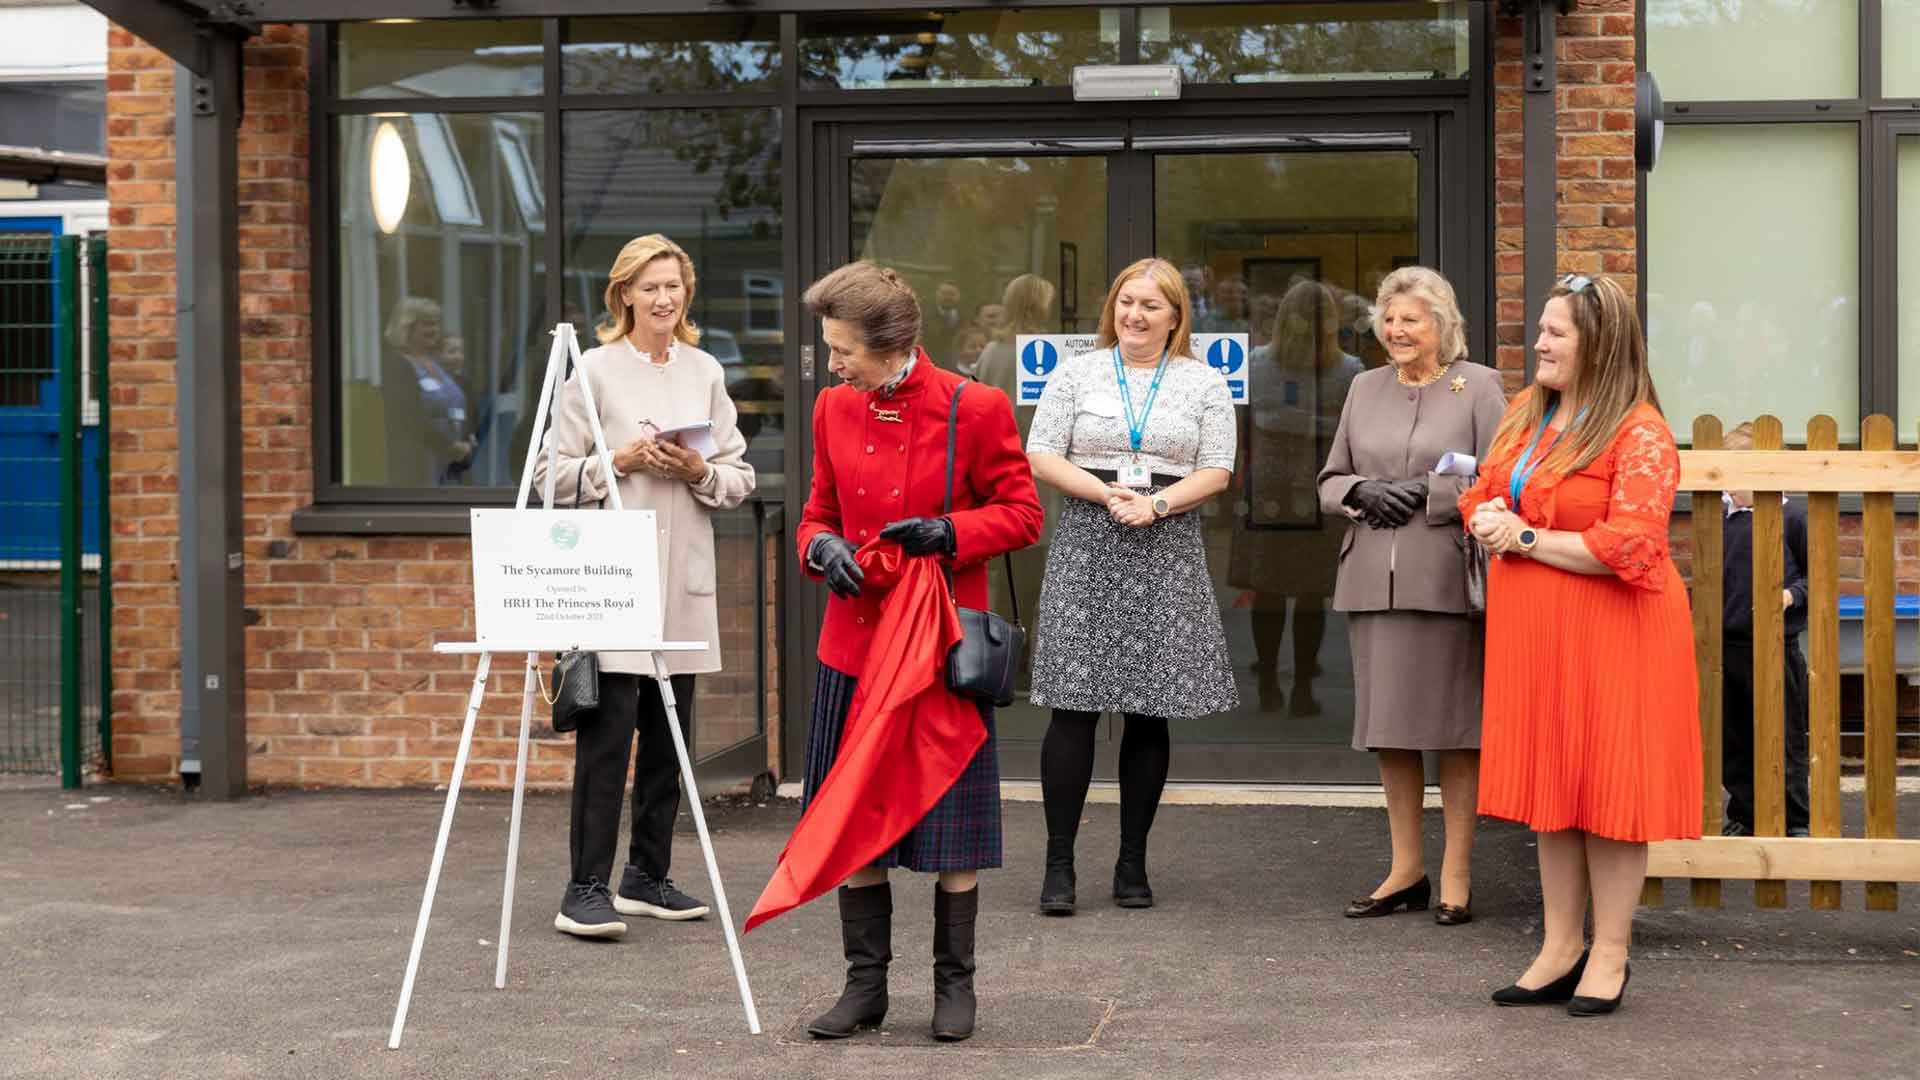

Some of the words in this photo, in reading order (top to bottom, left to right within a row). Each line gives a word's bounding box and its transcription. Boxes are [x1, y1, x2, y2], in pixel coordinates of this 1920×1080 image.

[1065, 339, 1097, 348] AUTOMA
[502, 565, 523, 575] The
[526, 565, 580, 578] Sycamore
[584, 565, 633, 578] Building
[546, 585, 576, 594] Opened
[503, 598, 531, 608] HRH
[534, 598, 554, 608] The
[558, 598, 601, 608] Princess
[604, 598, 634, 611] Royal
[535, 612, 554, 621] 22nd
[556, 612, 585, 621] October
